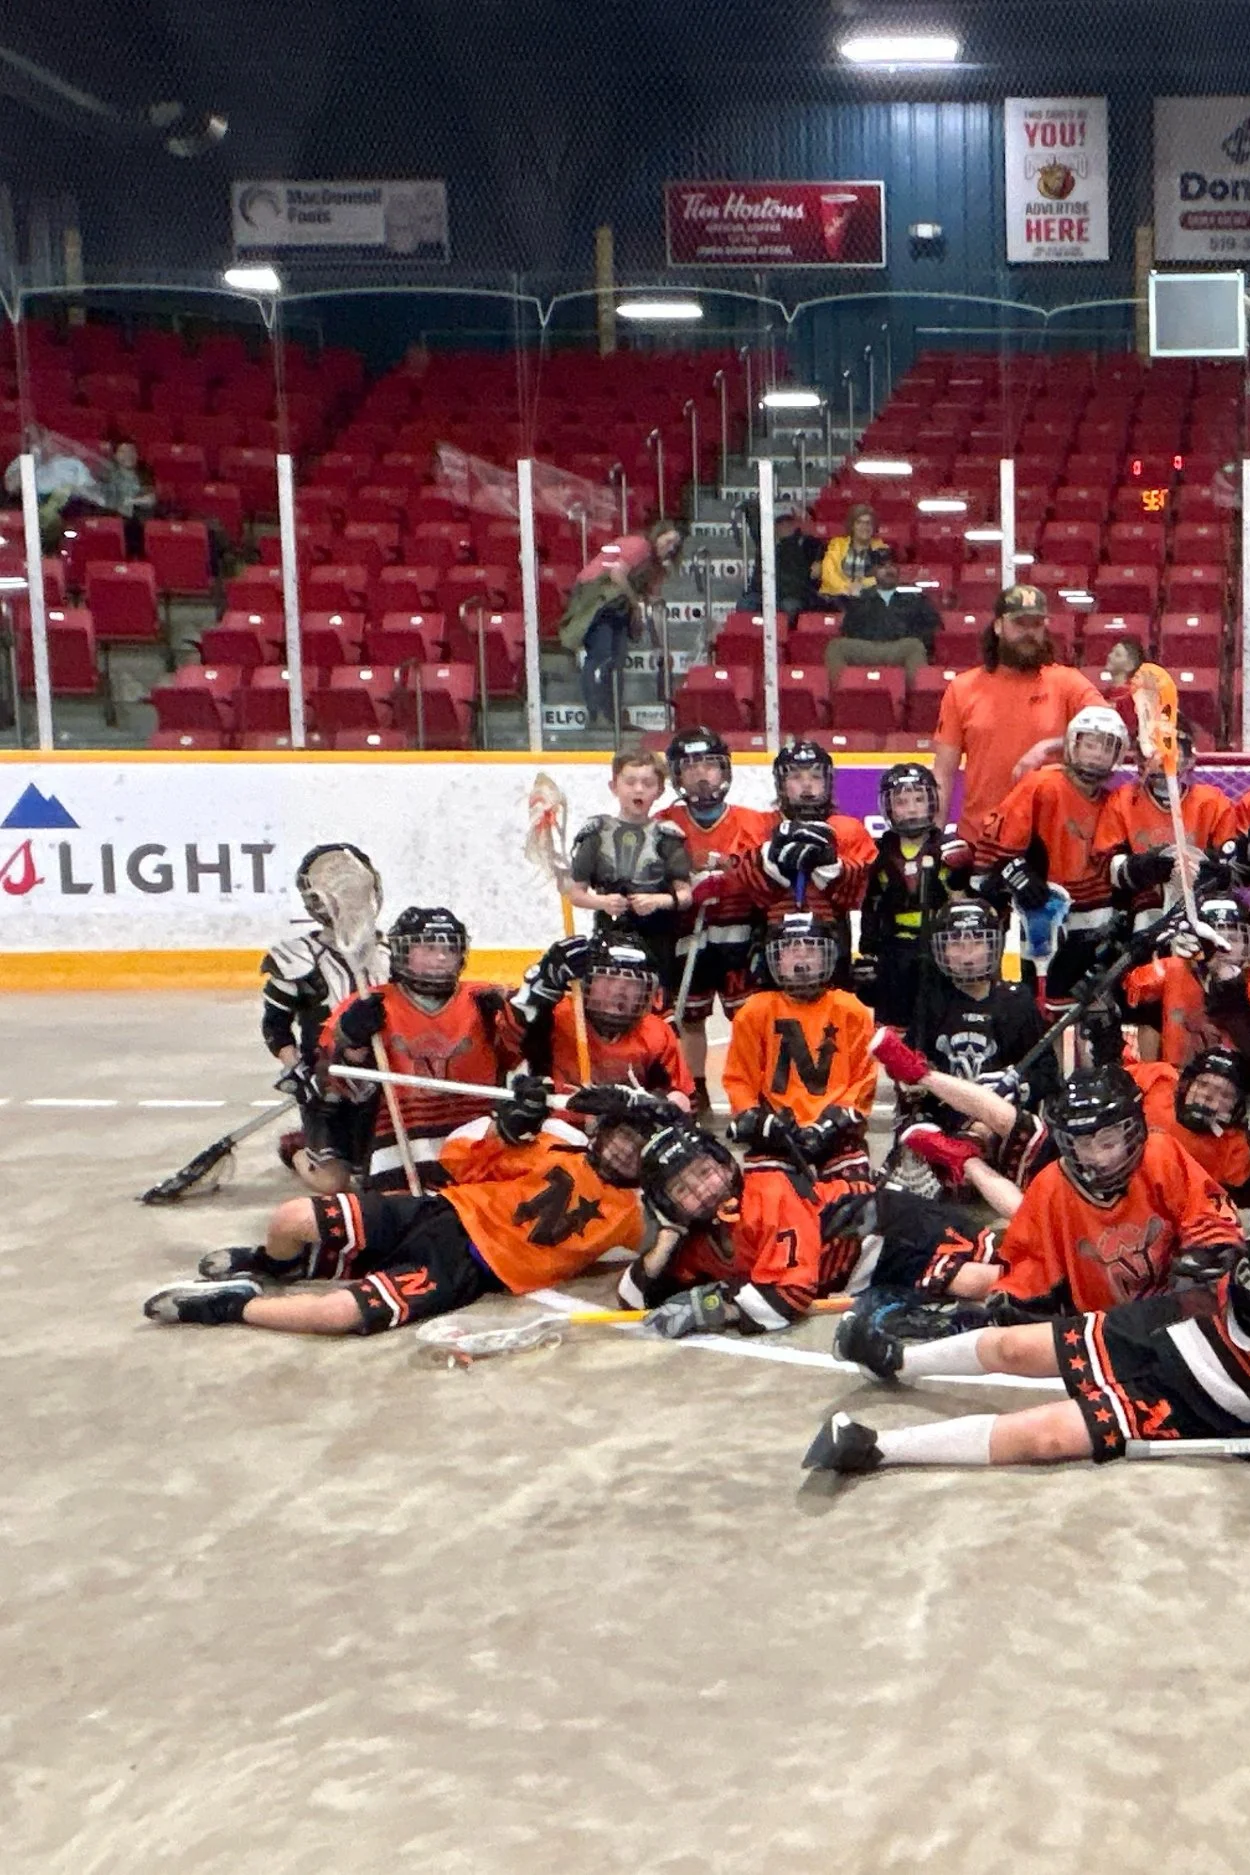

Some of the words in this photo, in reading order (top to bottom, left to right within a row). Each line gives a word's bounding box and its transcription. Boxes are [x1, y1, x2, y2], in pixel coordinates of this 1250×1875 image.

[1024, 121, 1086, 147] YOU!
[681, 193, 720, 219] Tim
[722, 191, 806, 219] Hortons
[1025, 201, 1089, 216] ADVERTISE
[1025, 218, 1090, 243] HERE
[58, 840, 276, 895] LIGHT
[771, 1018, 840, 1096] N
[776, 1229, 799, 1269] 7
